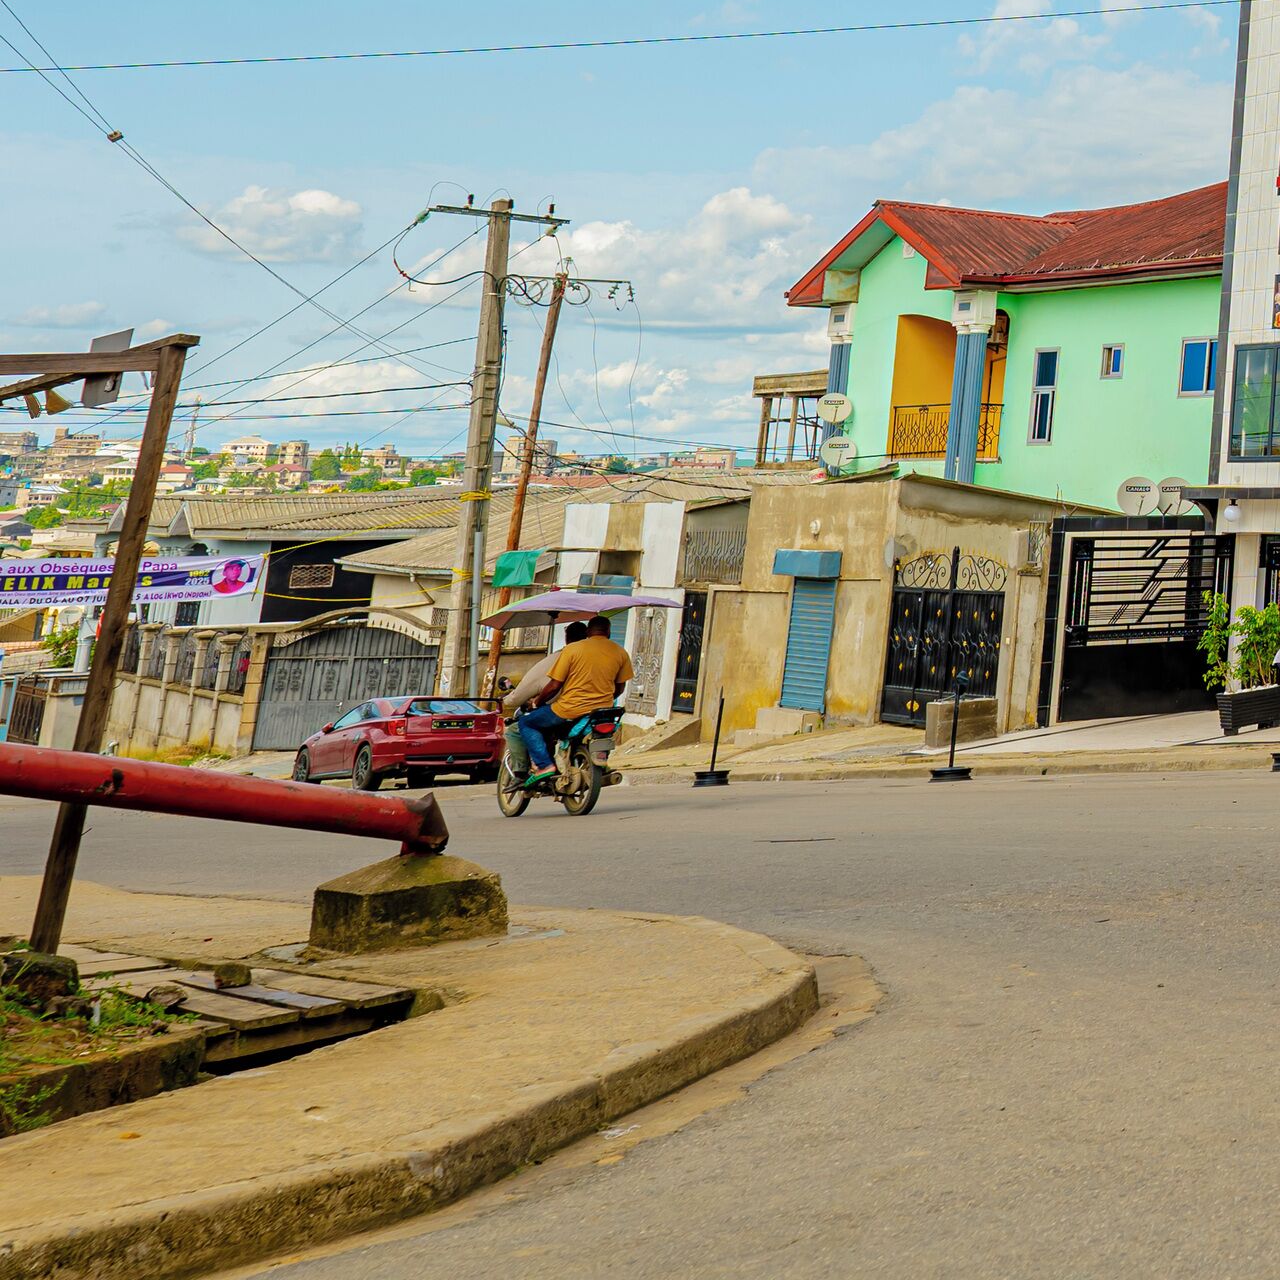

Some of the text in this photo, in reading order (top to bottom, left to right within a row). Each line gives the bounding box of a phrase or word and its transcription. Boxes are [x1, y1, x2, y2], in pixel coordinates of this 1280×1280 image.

[7, 565, 36, 574] aux
[41, 562, 115, 575] Obsèques
[142, 561, 178, 572] Papa
[0, 576, 55, 591] ELIX
[185, 577, 210, 586] 2025
[44, 595, 59, 604] 06
[76, 595, 91, 603] 07
[92, 594, 106, 603] JUI
